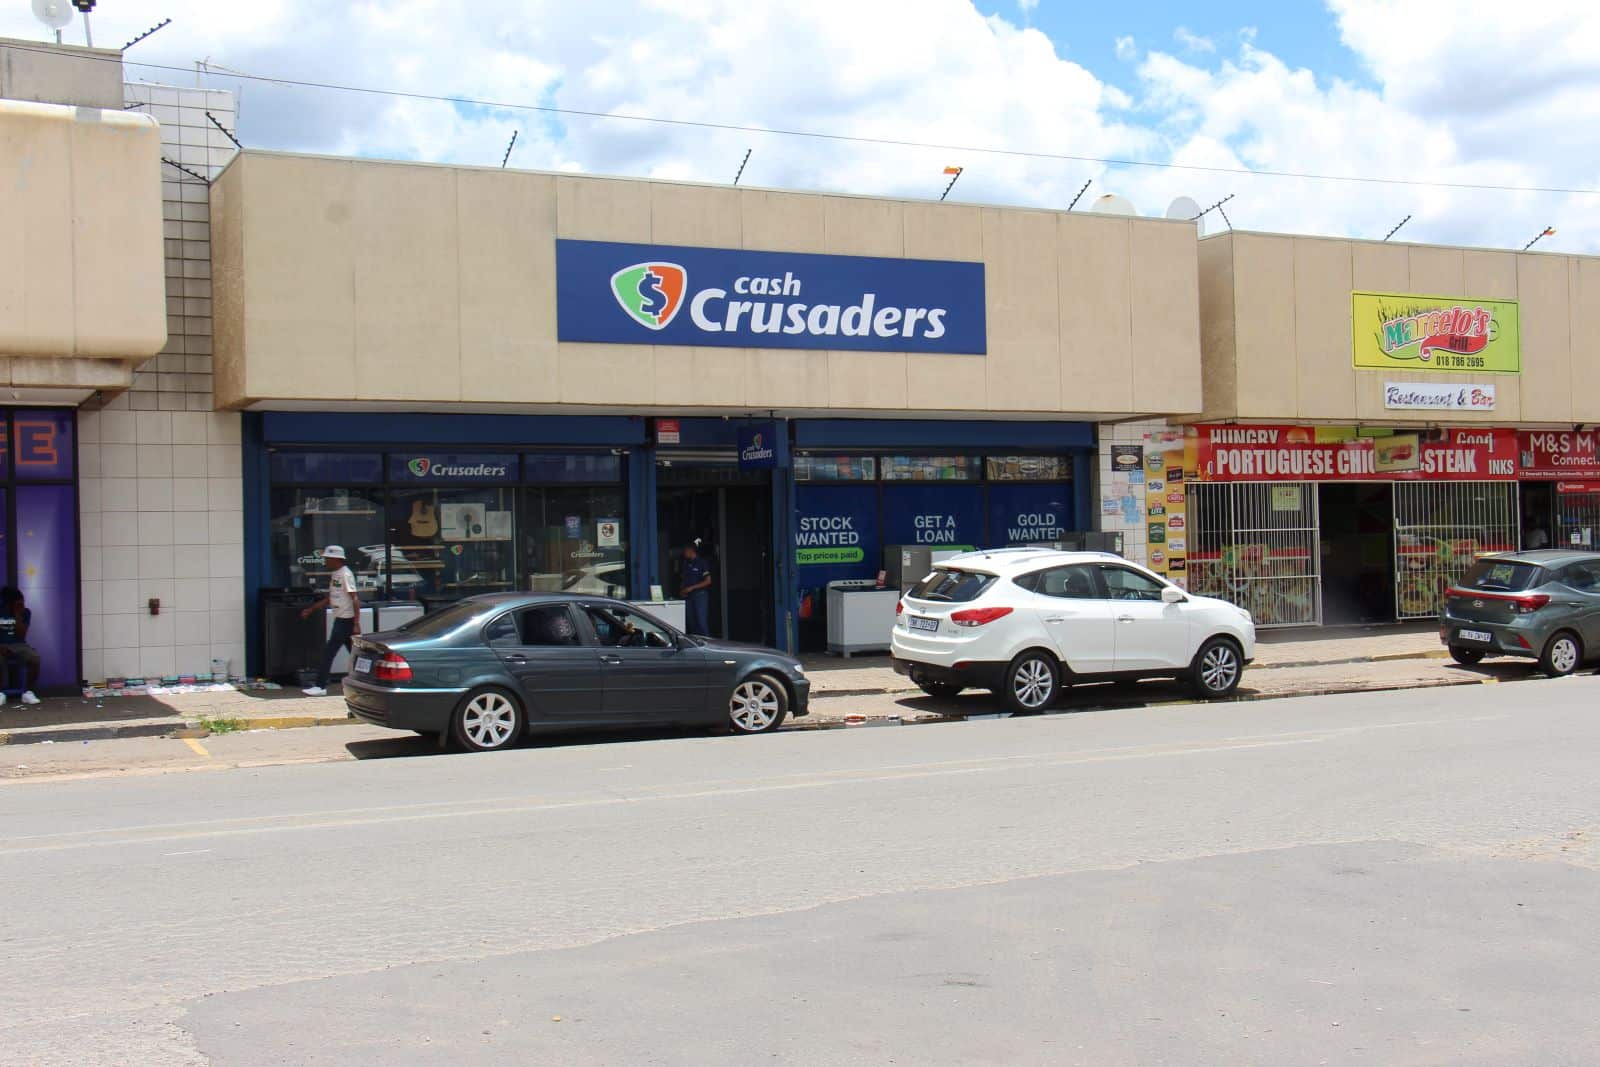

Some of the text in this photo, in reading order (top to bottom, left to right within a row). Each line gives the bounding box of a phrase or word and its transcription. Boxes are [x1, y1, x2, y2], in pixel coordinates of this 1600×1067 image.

[733, 271, 801, 296] cash
[690, 287, 947, 339] Crusaders
[1384, 305, 1491, 352] Marcelo's
[1449, 337, 1468, 351] Grill
[1436, 355, 1449, 367] 018
[1471, 388, 1496, 407] Bar
[1210, 429, 1279, 444] HUNGRY
[1530, 433, 1571, 453] M&S
[742, 448, 773, 461] Crusaders
[1216, 449, 1334, 475] PORTUGUESE
[1337, 449, 1375, 475] CHIC
[431, 463, 506, 476] Crusaders
[1488, 459, 1514, 475] INKS
[800, 516, 853, 531] STOCK
[914, 515, 956, 528] GET A
[1017, 513, 1056, 526] GOLD
[795, 531, 860, 546] WANTED
[916, 529, 955, 542] LOAN
[797, 550, 858, 561] Top prices paid
